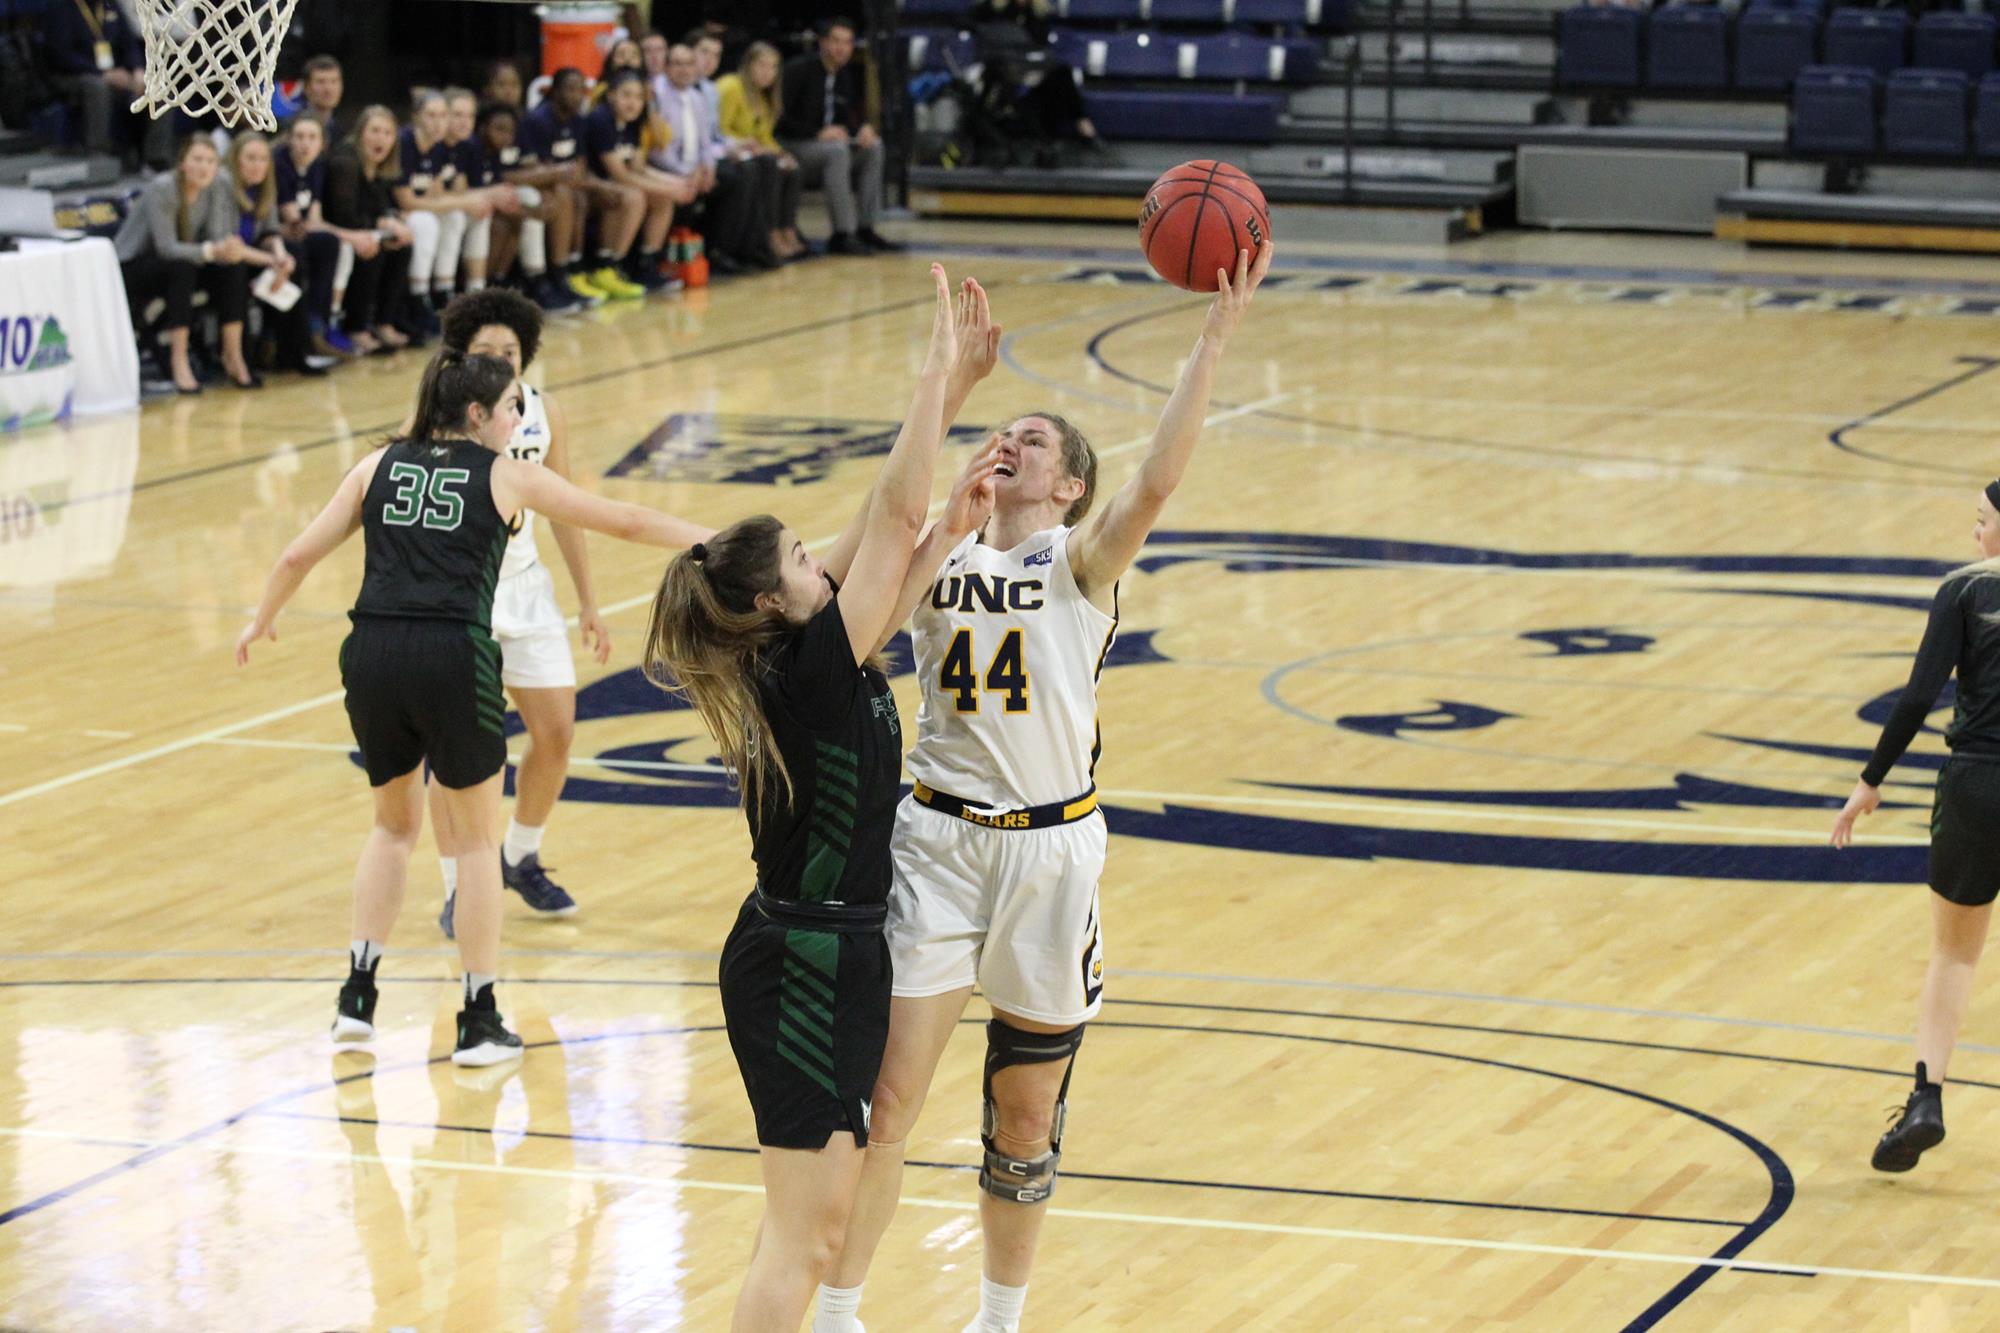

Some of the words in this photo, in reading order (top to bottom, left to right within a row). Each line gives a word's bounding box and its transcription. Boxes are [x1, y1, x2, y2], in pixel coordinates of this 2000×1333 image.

[382, 461, 470, 532] 35
[931, 573, 1044, 614] UNC
[940, 626, 1031, 715] 44
